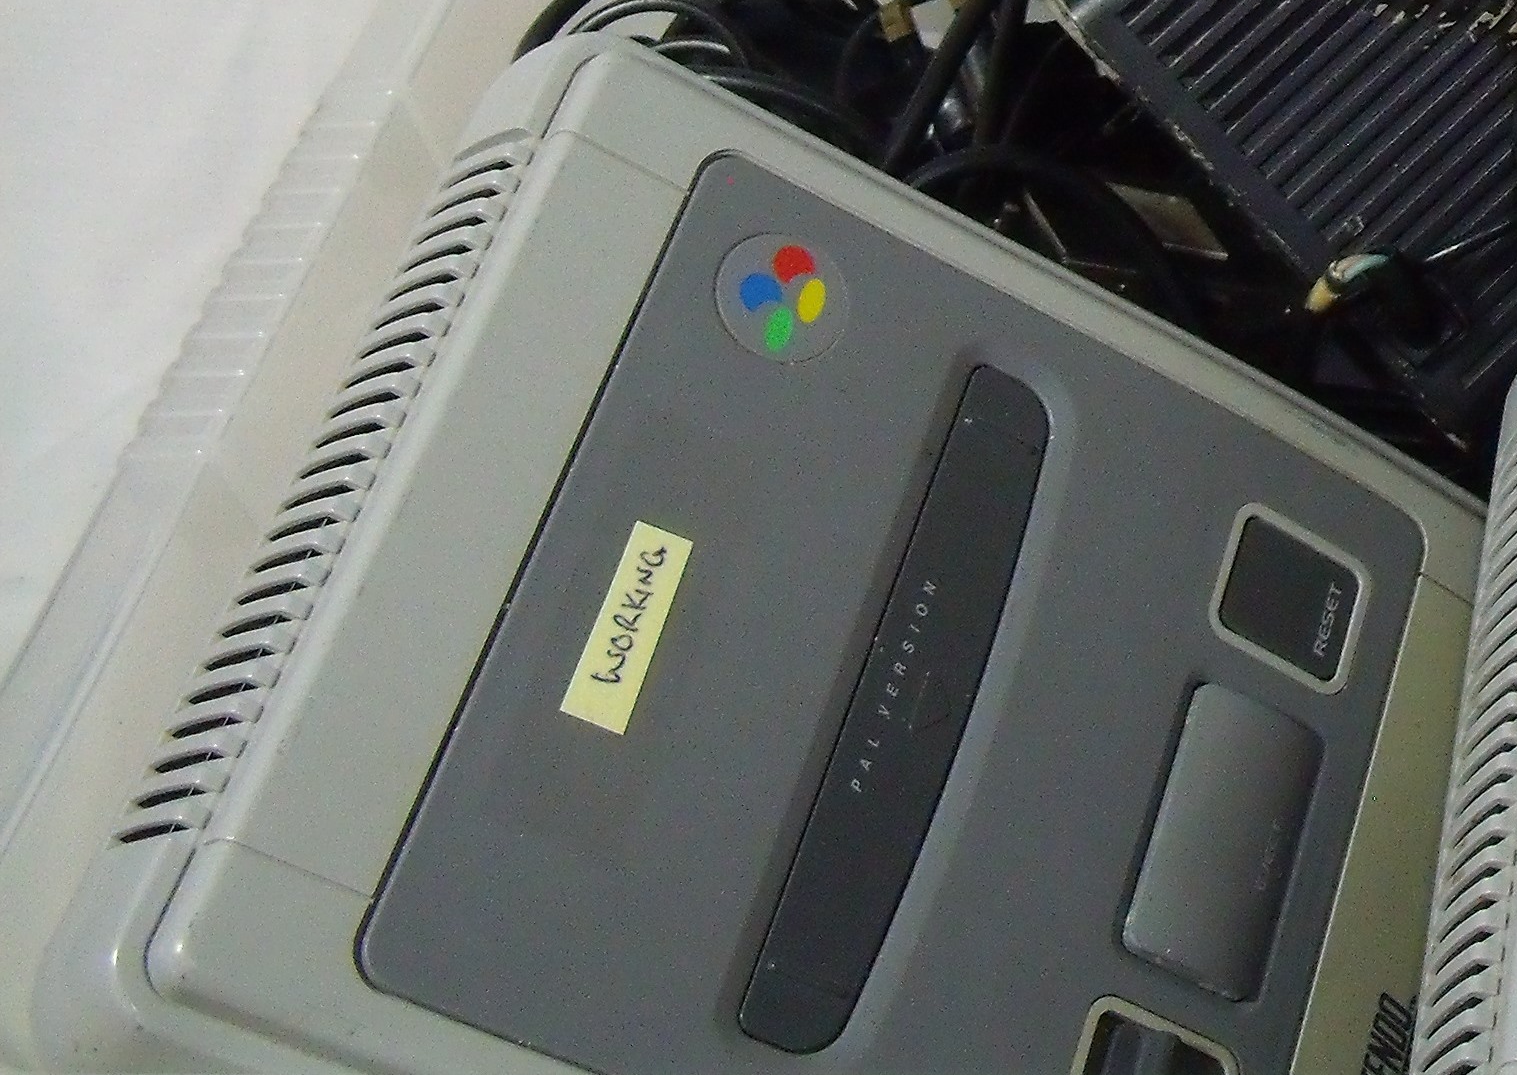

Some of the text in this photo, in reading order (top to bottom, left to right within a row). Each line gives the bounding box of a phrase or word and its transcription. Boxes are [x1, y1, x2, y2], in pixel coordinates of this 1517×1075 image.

[590, 546, 668, 686] WORKING
[850, 578, 937, 793] PAL VERSION
[1312, 579, 1344, 658] RESET
